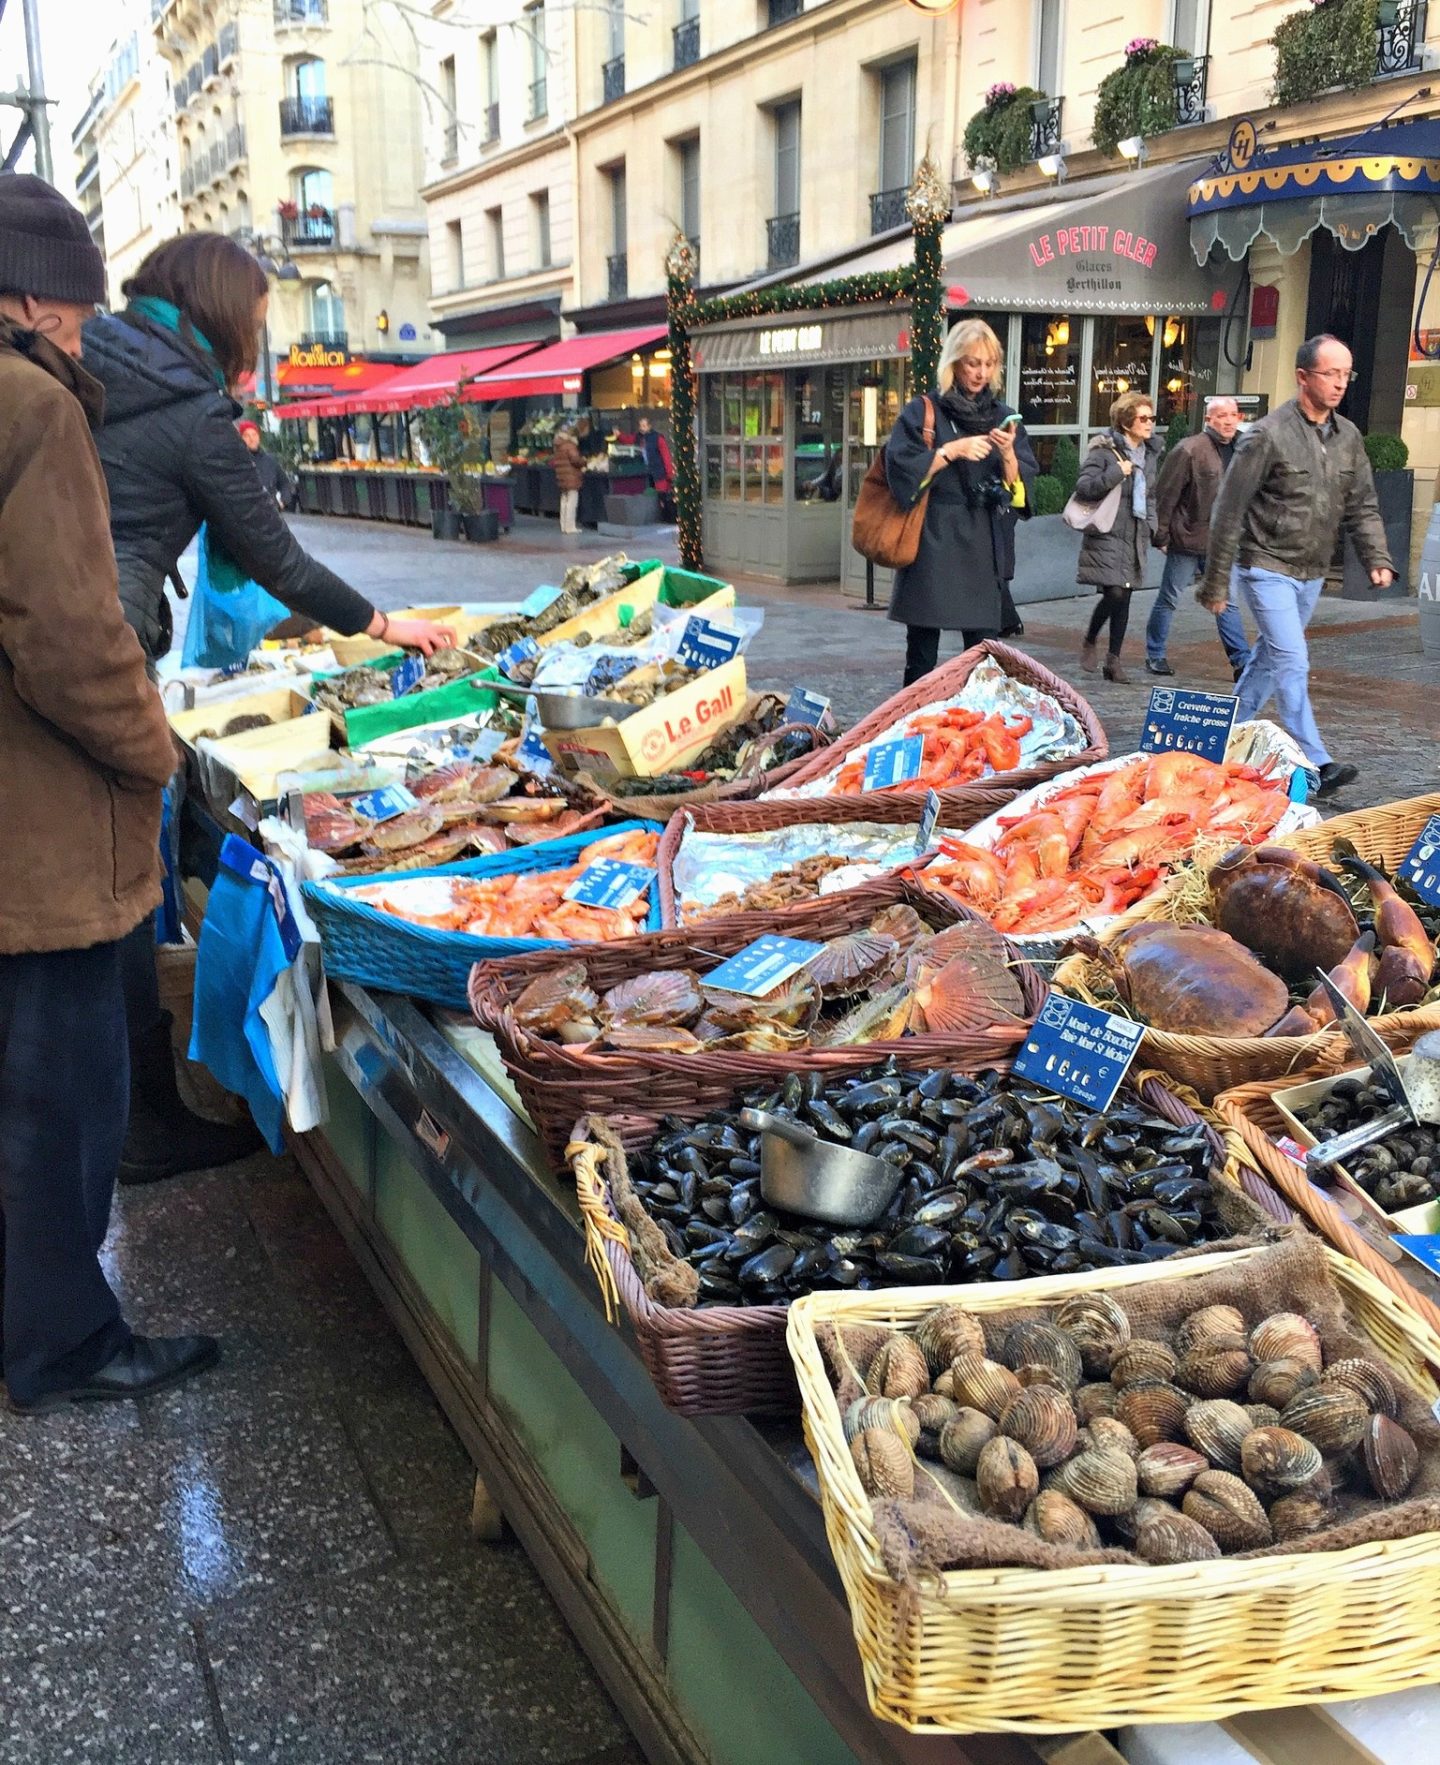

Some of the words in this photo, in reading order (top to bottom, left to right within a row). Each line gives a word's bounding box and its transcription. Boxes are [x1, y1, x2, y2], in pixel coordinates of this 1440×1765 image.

[1029, 234, 1055, 267] LE
[1056, 226, 1109, 255] PETIT
[1113, 229, 1158, 268] CLER
[1075, 259, 1112, 273] Glaces
[1066, 277, 1122, 293] Berthillon
[664, 716, 692, 743] Le
[695, 686, 733, 725] Gall
[1178, 701, 1211, 713] Crevette
[1212, 704, 1231, 715] rose
[1202, 717, 1230, 728] grosse
[1066, 1016, 1091, 1034] Moule
[1090, 1026, 1104, 1039] de
[1101, 1030, 1136, 1051] Bouchot
[1059, 1029, 1078, 1044] Baie
[1076, 1035, 1097, 1051] Mont
[1094, 1042, 1105, 1055] St
[1103, 1046, 1131, 1065] Michel
